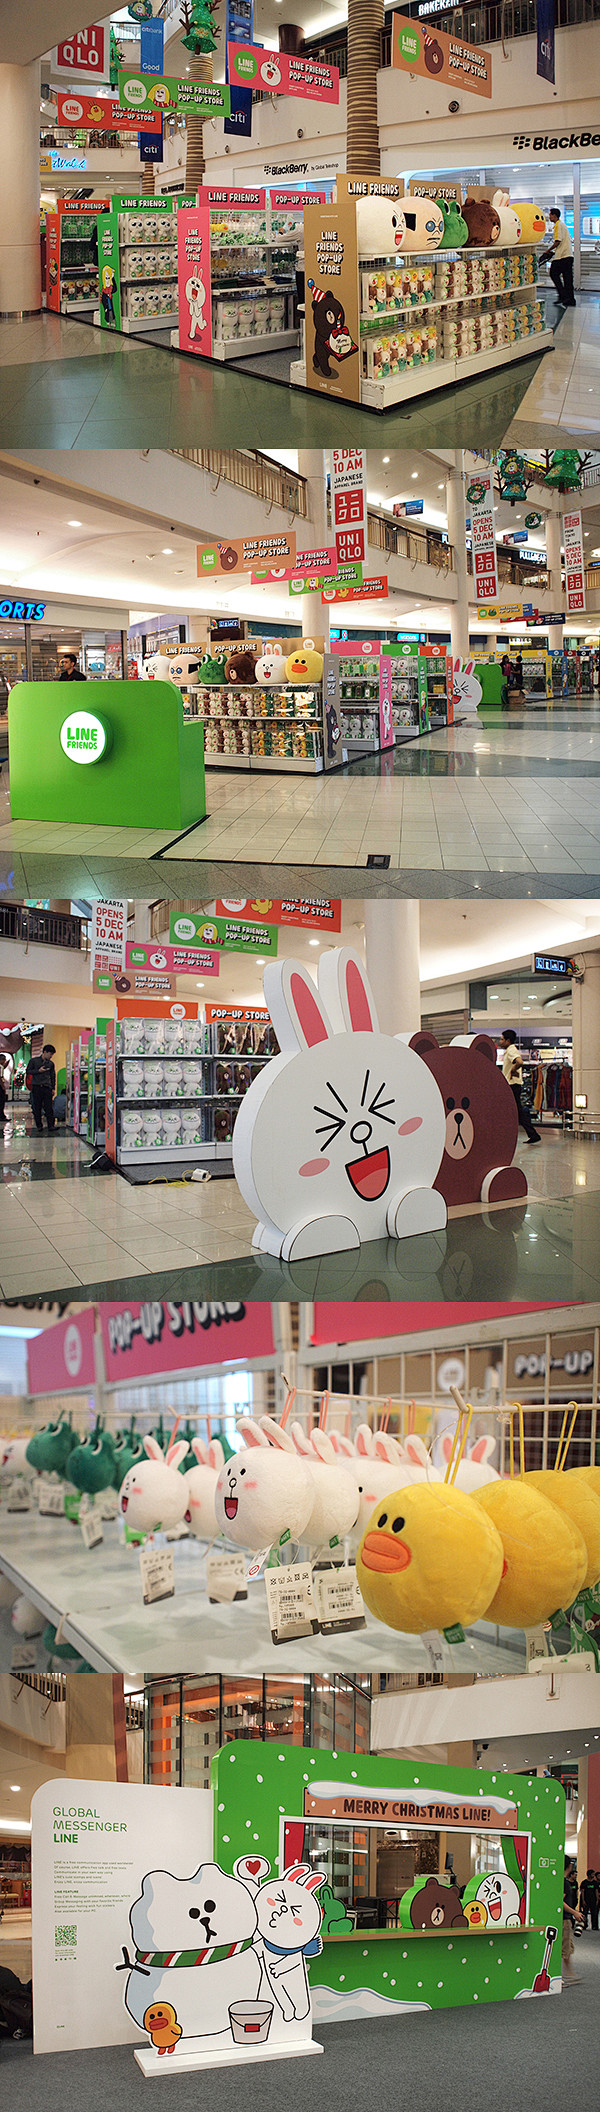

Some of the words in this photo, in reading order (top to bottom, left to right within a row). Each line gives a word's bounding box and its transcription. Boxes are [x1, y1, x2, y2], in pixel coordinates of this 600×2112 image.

[66, 29, 96, 46] NI
[402, 36, 417, 48] LINE
[63, 45, 98, 66] QLO
[449, 43, 463, 57] LINE
[464, 48, 486, 68] FRIENDS
[142, 62, 160, 70] Good
[238, 58, 254, 68] LINE
[288, 60, 304, 72] LINE
[305, 64, 330, 78] FRIENDS
[448, 56, 470, 74] POP-UP
[470, 66, 488, 80] STORE
[288, 70, 314, 84] POP-UP
[314, 76, 333, 89] STORE
[178, 84, 193, 94] LINE
[194, 86, 220, 96] FRIENDS
[178, 94, 204, 104] POP-UP
[204, 96, 224, 106] STORE
[112, 112, 136, 121] POP-UP
[137, 114, 156, 122] STORE
[229, 110, 246, 124] citi
[144, 145, 158, 154] citi
[272, 163, 308, 175] BlackBerry
[348, 182, 368, 195] LINE
[369, 183, 400, 197] FRIENDS
[414, 186, 437, 198] POP-UP
[438, 188, 457, 200] STORE
[120, 200, 138, 208] LINE
[138, 200, 167, 208] FRIENDS
[208, 192, 228, 203] LINE
[228, 194, 260, 204] FRIENDS
[276, 195, 300, 205] POP-UP
[300, 196, 321, 205] STORE
[80, 202, 106, 210] FRIENDS
[188, 228, 199, 236] LINE
[320, 232, 338, 242] LINE
[316, 242, 344, 253] FRIENDS
[316, 254, 343, 264] POP-UP
[319, 264, 341, 276] STORE
[333, 450, 339, 461] 5
[342, 449, 362, 459] DEC
[334, 463, 344, 474] 10
[346, 458, 362, 472] AM
[334, 473, 363, 484] JAPANESE
[472, 516, 492, 526] OPENS
[479, 524, 493, 532] DEC
[338, 533, 360, 546] UNI
[482, 532, 494, 540] AM
[243, 541, 258, 550] LINE
[259, 538, 287, 547] FRIENDS
[243, 550, 268, 559] POP-UP
[268, 546, 290, 556] STORE
[304, 551, 328, 560] FRIENDS
[339, 546, 362, 560] QLO
[294, 560, 312, 569] OP-UP
[313, 558, 331, 567] STORE
[338, 567, 355, 575] RIENDS
[364, 578, 382, 586] FRIENDS
[478, 578, 492, 588] UNI
[478, 586, 494, 597] QLO
[0, 600, 46, 620] ORTS
[166, 647, 178, 655] LINE
[179, 646, 202, 654] FRIENDS
[214, 644, 235, 653] POP-UP
[236, 643, 257, 651] STORE
[66, 727, 98, 741] LINE
[66, 741, 98, 750] FRIENDS
[96, 899, 124, 908] JAKARTA
[96, 907, 124, 919] OPENS
[281, 902, 310, 914] POP-UP
[310, 906, 334, 918] STORE
[96, 917, 102, 926] 5
[104, 919, 123, 930] DEC
[96, 928, 106, 938] 10
[108, 931, 123, 941] AM
[225, 924, 241, 932] LINE
[242, 926, 268, 936] FRIENDS
[225, 932, 250, 942] POP-UP
[251, 935, 271, 945] STORE
[95, 941, 122, 950] JAPANESE
[188, 952, 211, 960] FRIENDS
[211, 1008, 243, 1020] POP-UP
[244, 1009, 270, 1020] STORE
[108, 1302, 164, 1354] POP-UP
[514, 1350, 594, 1378] POP-UP
[52, 1806, 100, 1818] GLOBAL
[343, 1799, 388, 1815] MERRY
[392, 1802, 459, 1819] CHRISTMAS
[462, 1808, 491, 1821] LINE!
[53, 1820, 127, 1832] MESSENGER
[54, 1833, 78, 1843] LINE
